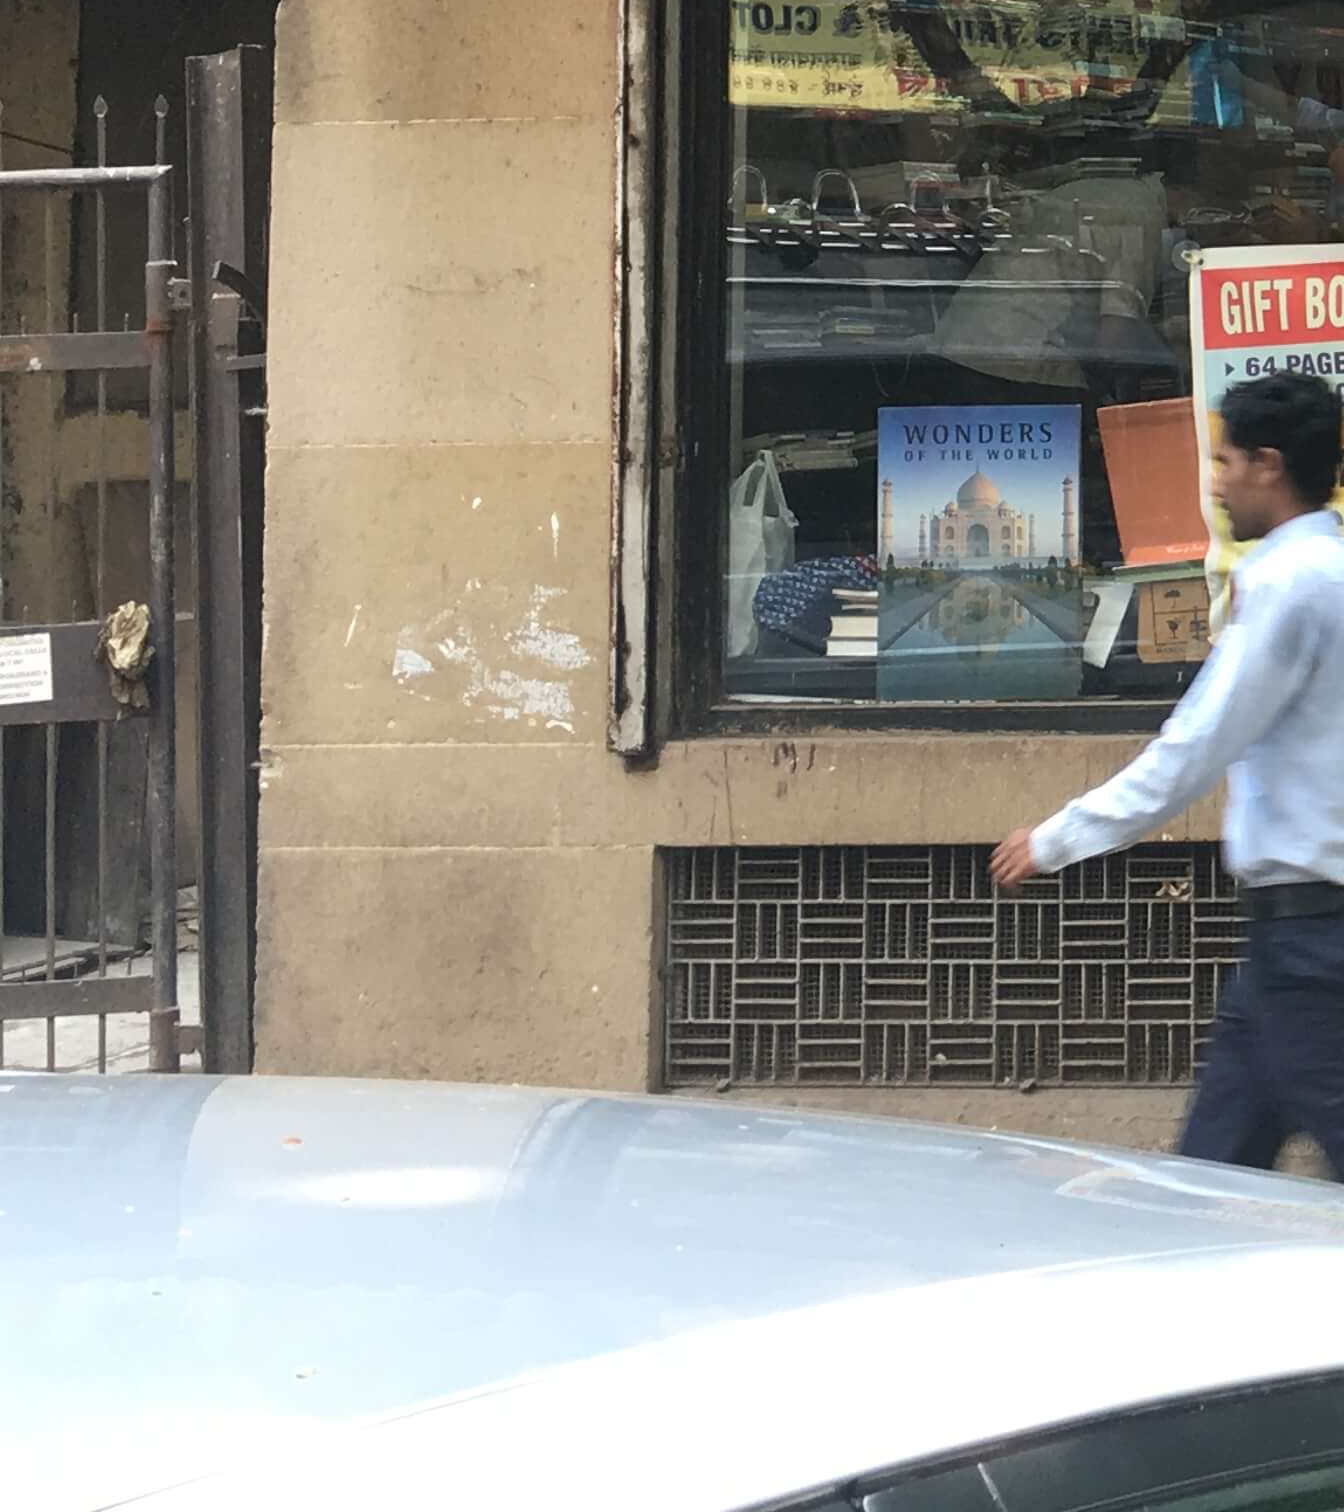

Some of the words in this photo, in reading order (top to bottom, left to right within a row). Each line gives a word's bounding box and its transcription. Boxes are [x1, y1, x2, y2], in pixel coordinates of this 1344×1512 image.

[1220, 279, 1293, 335] GIFT
[1245, 356, 1277, 376] 64
[904, 422, 1052, 445] WONDERS
[904, 450, 926, 462] OF
[940, 449, 974, 461] THE
[987, 448, 1053, 460] WORLD
